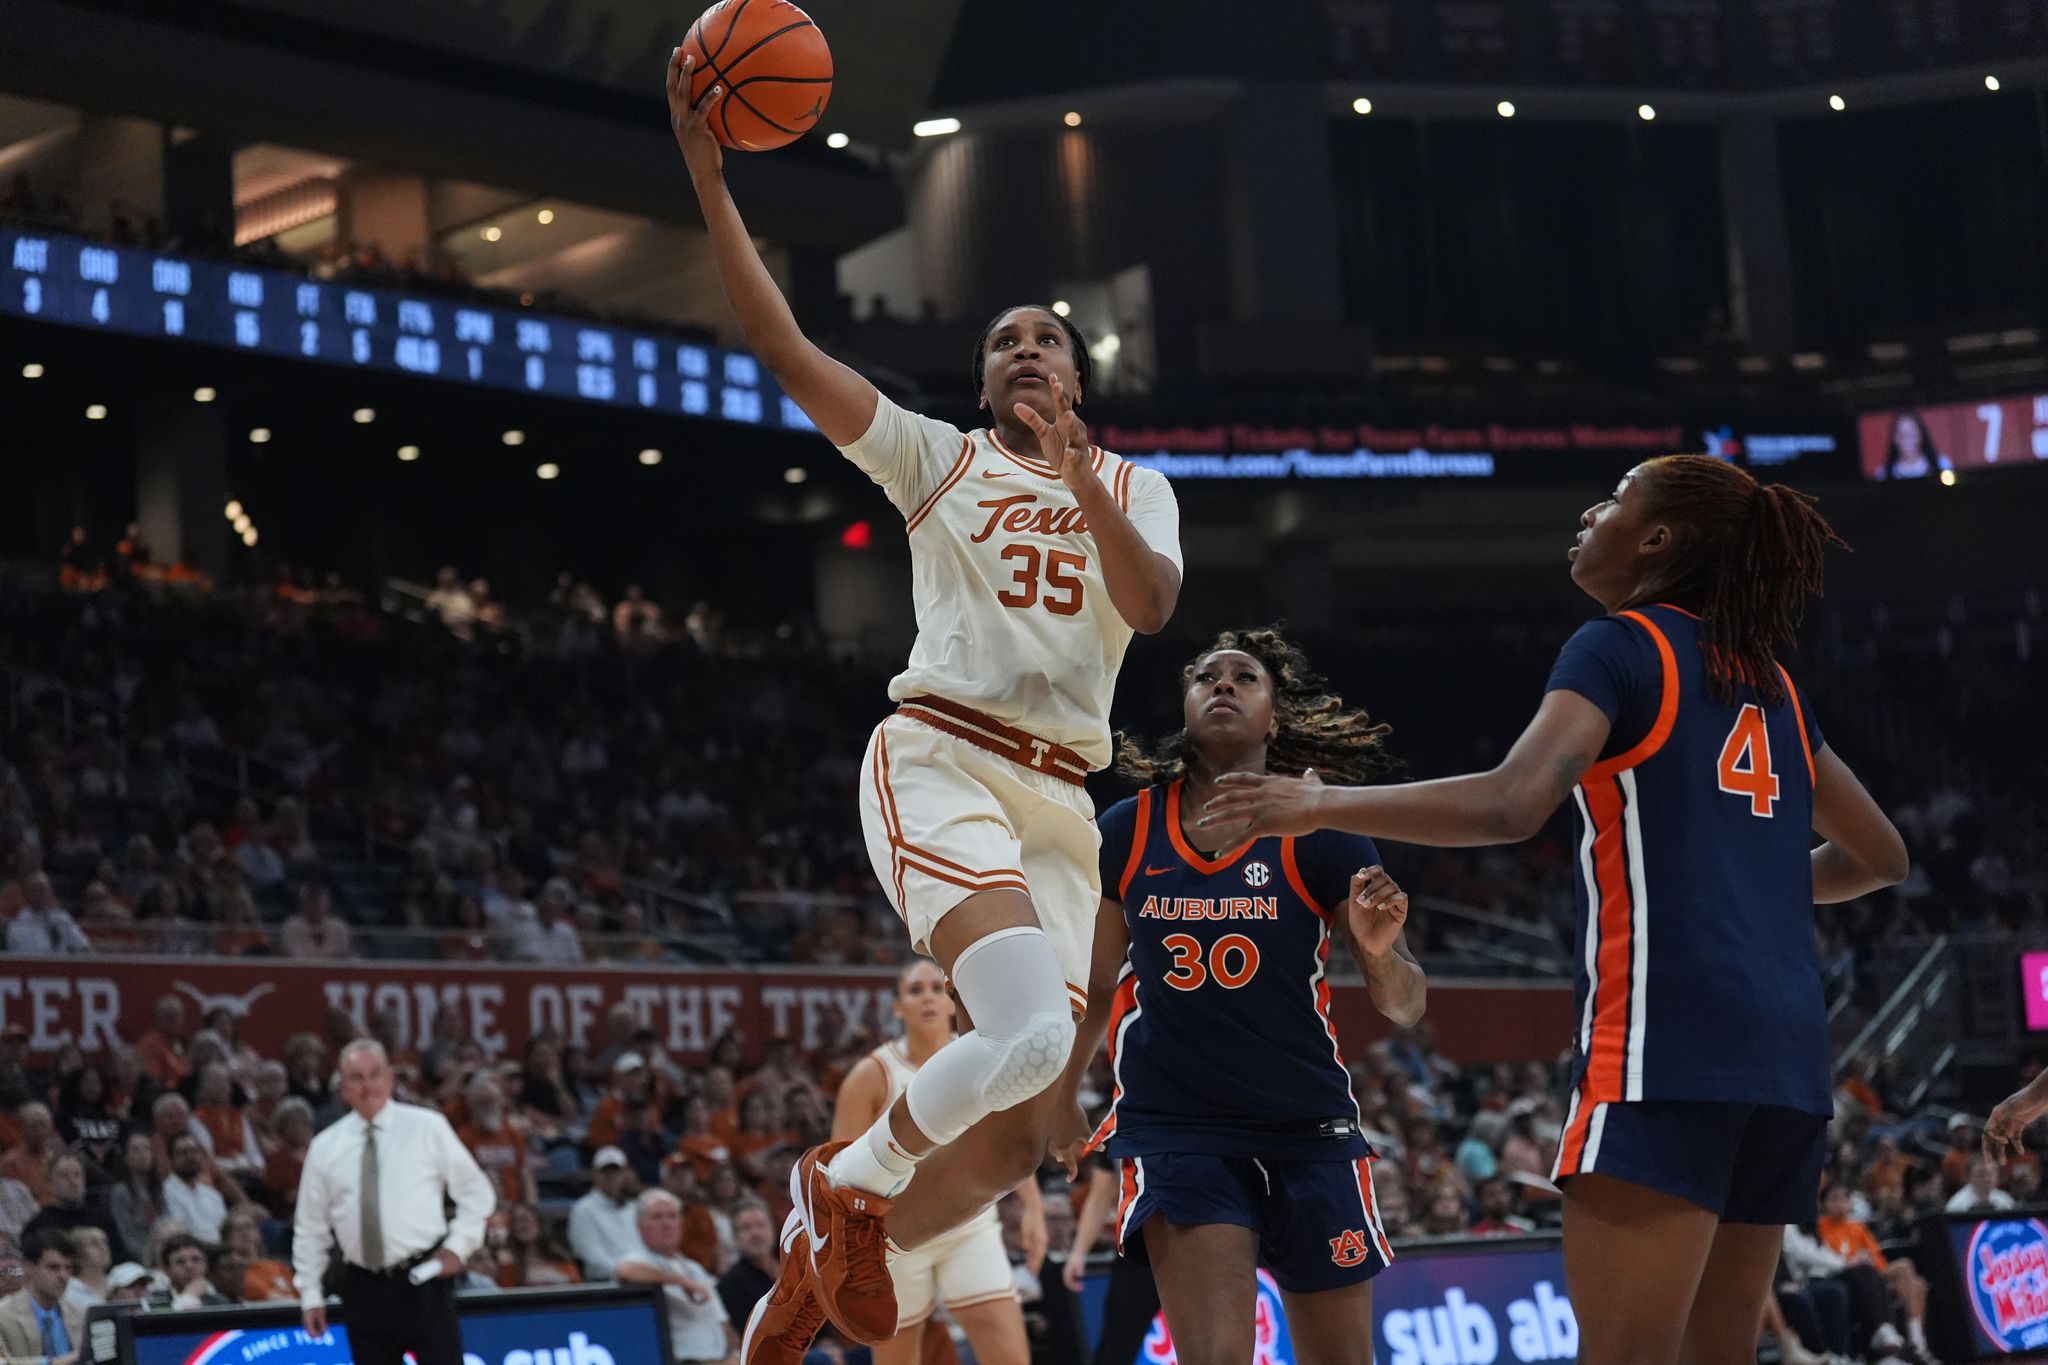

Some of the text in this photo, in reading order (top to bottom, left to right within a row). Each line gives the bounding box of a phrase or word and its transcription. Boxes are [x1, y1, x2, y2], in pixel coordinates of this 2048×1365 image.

[301, 321, 320, 357] 2
[467, 346, 483, 382] 1
[1976, 403, 2003, 463] 7
[970, 494, 1088, 543] Texa
[998, 543, 1087, 616] 35
[1717, 703, 1779, 818] 4
[1244, 862, 1270, 887] SEC
[1139, 895, 1278, 921] AUBURN
[1161, 933, 1260, 991] 30
[1383, 1286, 1498, 1365] sub
[1507, 1281, 1578, 1361] ab
